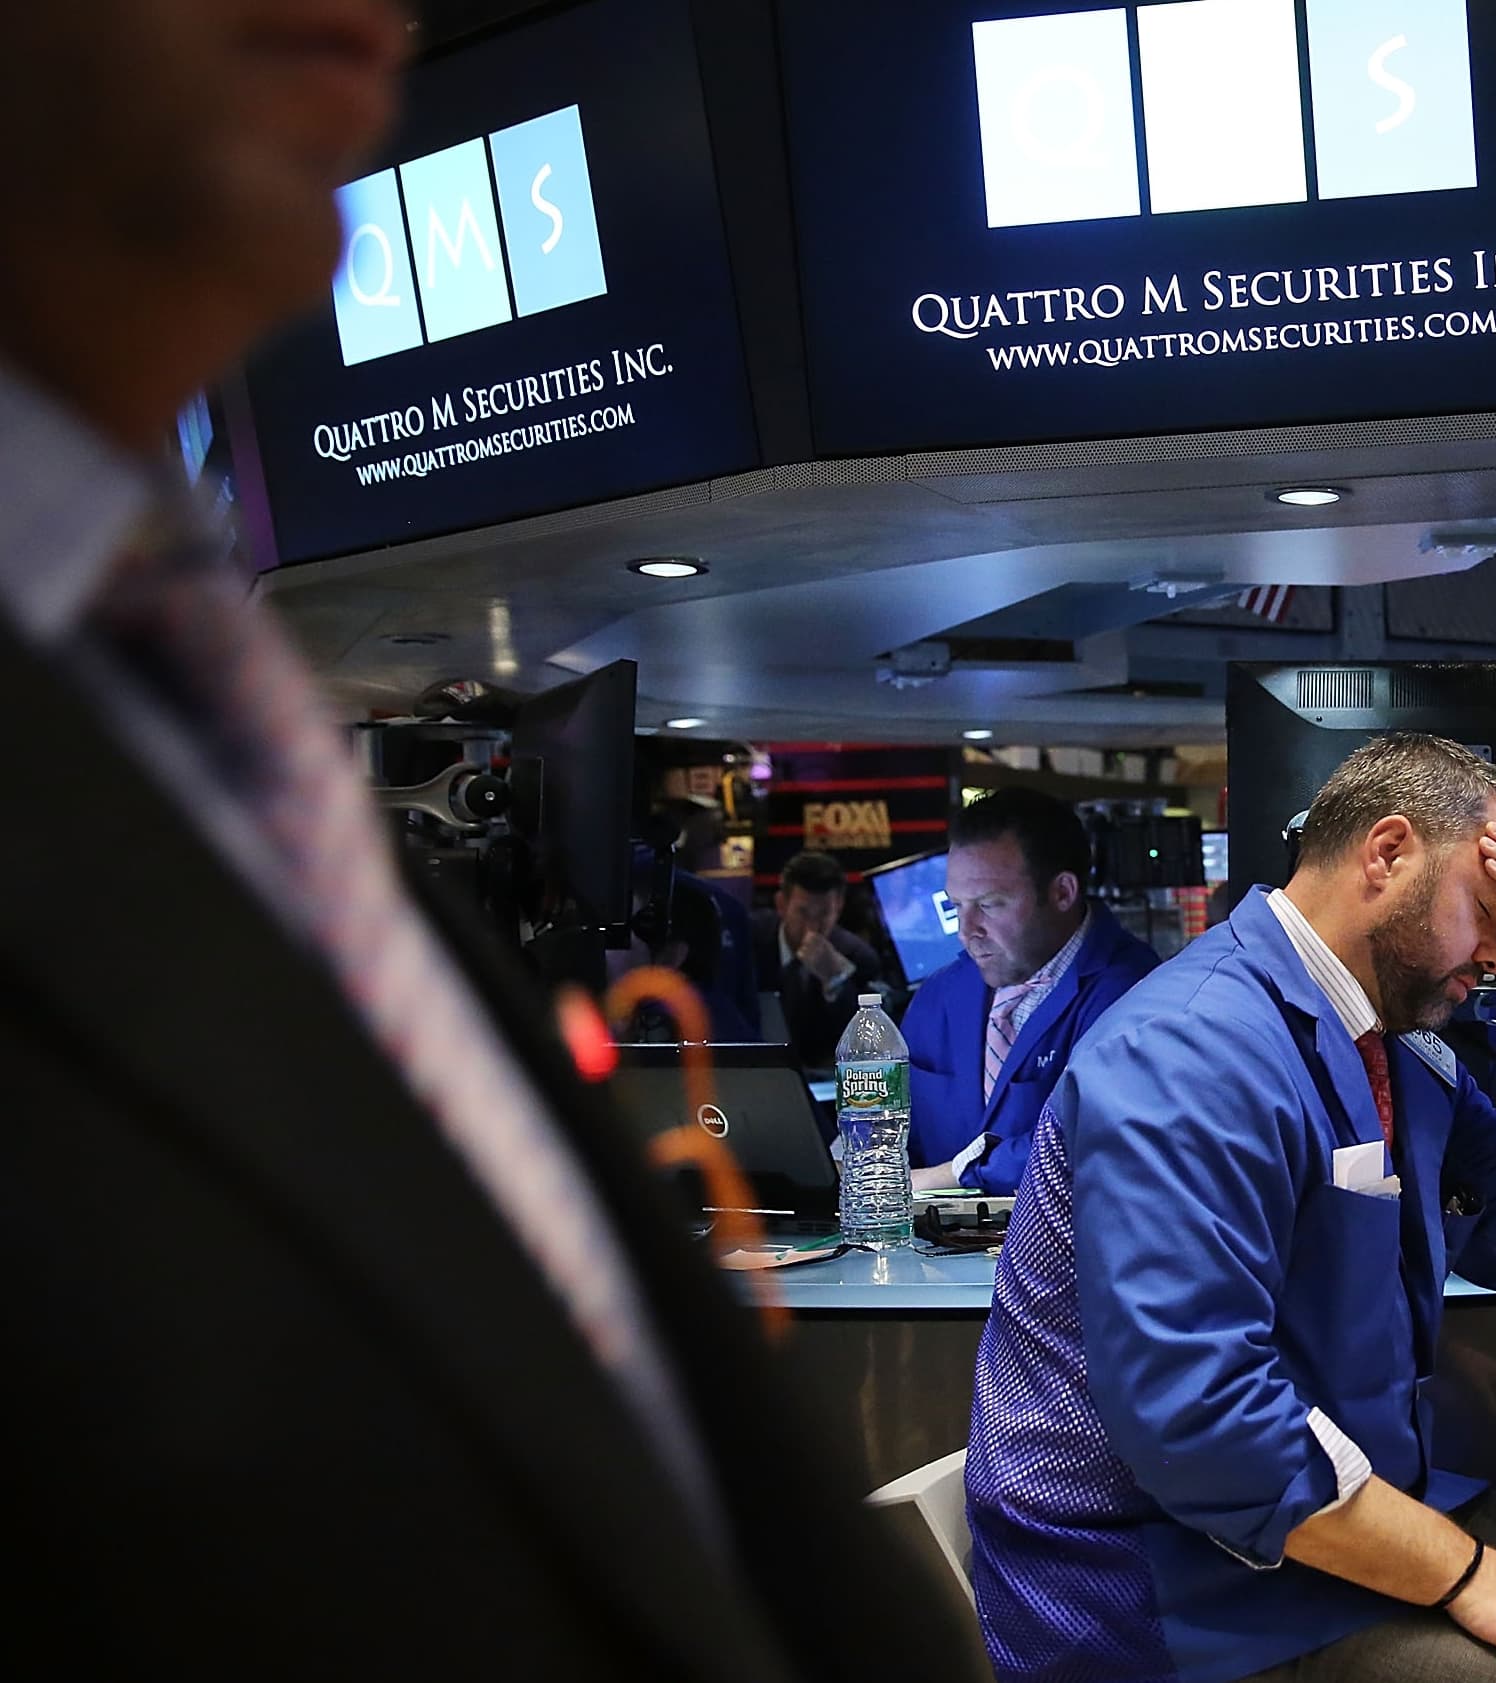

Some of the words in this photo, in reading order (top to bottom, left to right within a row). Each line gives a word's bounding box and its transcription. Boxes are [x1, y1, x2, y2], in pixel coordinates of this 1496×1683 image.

[911, 284, 1125, 340] QUATTRO
[1141, 273, 1188, 315] M
[1203, 257, 1454, 311] SECURITIES
[313, 405, 425, 462] QUATTRO
[431, 392, 459, 431] M
[462, 359, 604, 423] SECURITIES
[611, 343, 673, 386] INC.
[355, 402, 636, 486] WWW.QUATTROMSECURITIES.COM
[843, 1080, 889, 1098] Spring
[846, 1068, 883, 1080] Poland
